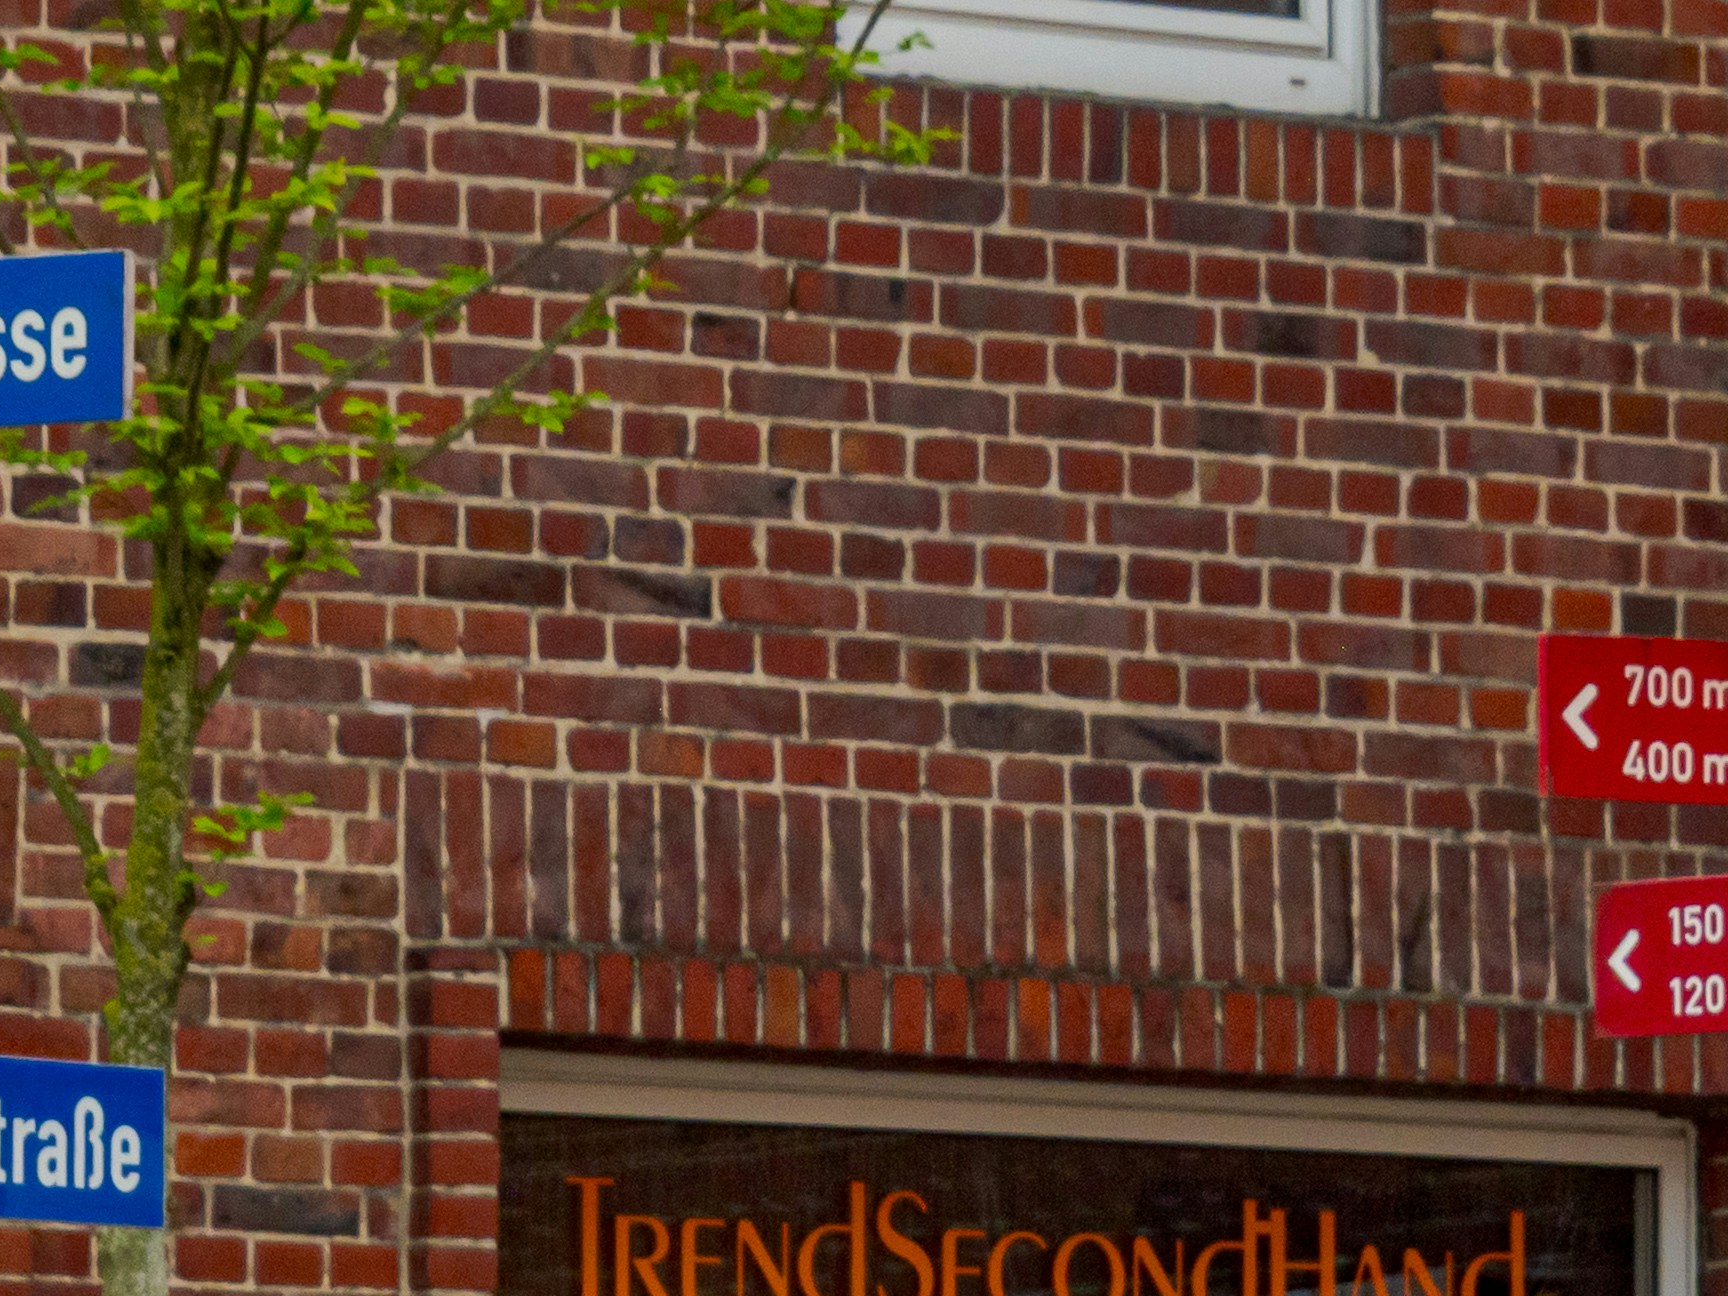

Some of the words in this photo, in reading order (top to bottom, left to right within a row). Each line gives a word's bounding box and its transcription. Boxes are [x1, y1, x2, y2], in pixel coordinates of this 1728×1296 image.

[1623, 665, 1696, 710] 700
[1622, 741, 1695, 784] 400
[1668, 906, 1724, 946] 150
[1669, 976, 1725, 1018] 120
